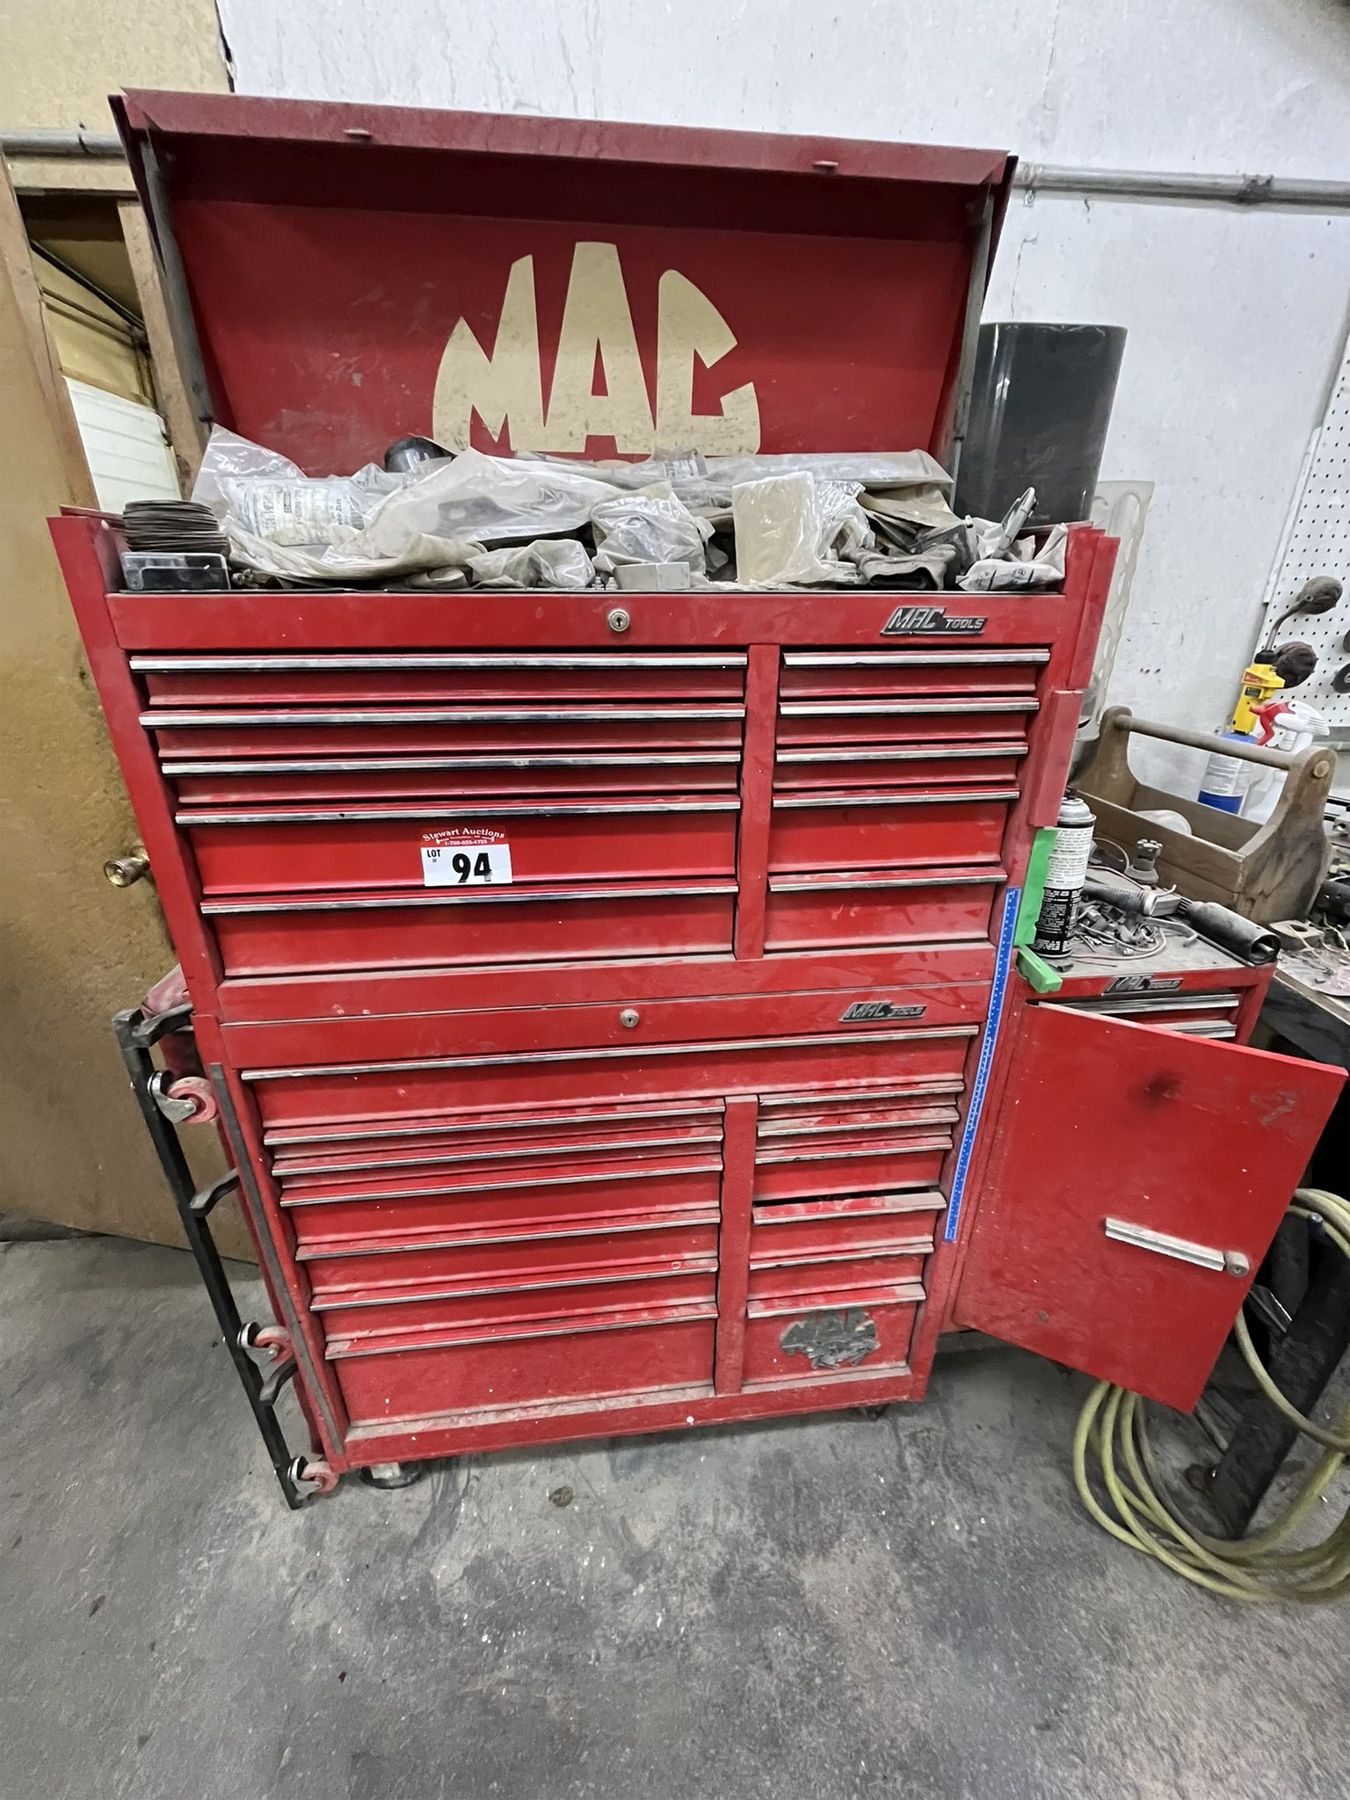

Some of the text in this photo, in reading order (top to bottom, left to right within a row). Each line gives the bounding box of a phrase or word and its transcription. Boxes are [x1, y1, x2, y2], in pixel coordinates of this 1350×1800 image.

[433, 241, 760, 457] MAC
[887, 608, 985, 629] MAC TOOLS
[422, 827, 505, 842] Stewart Auctions
[427, 849, 441, 858] LOT
[451, 852, 493, 884] 94
[844, 1002, 892, 1019] MAC
